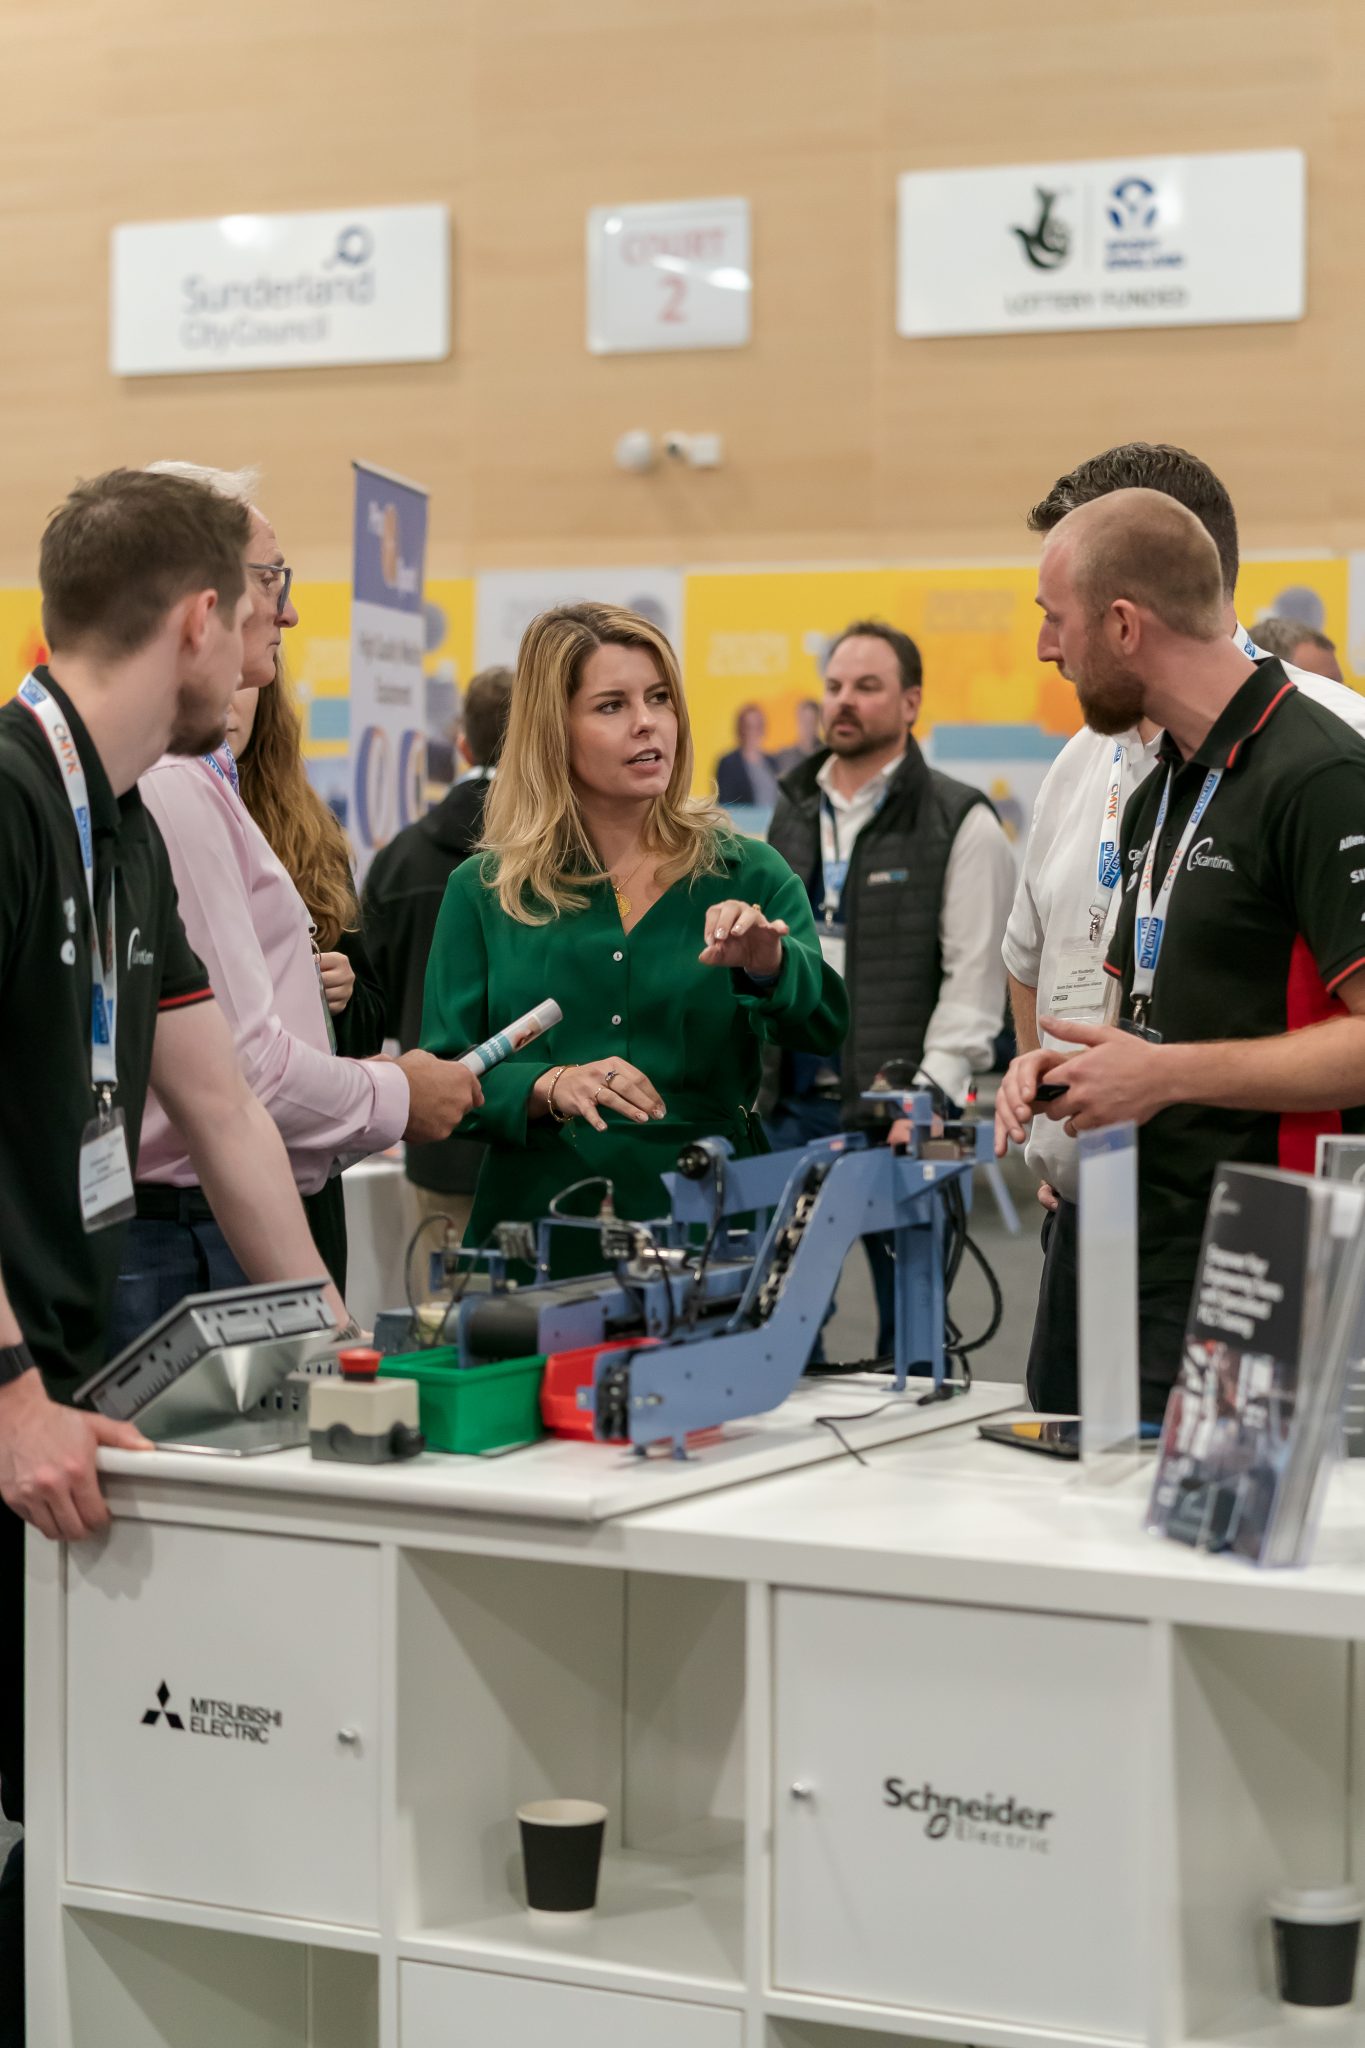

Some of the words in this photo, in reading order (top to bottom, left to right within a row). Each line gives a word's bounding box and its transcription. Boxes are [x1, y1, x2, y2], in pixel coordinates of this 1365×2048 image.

[182, 268, 375, 314] Sunderland
[656, 275, 688, 324] 2
[1101, 288, 1189, 311] FUNDED
[231, 315, 328, 347] Council
[53, 724, 79, 775] CMYK
[1106, 784, 1118, 819] CMYK
[1139, 917, 1158, 969] INVENTRY
[190, 1697, 282, 1727] MITSUBISHI
[190, 1717, 269, 1744] ELECTRIC
[884, 1777, 1053, 1831] Schneider
[955, 1819, 1050, 1854] Electric
